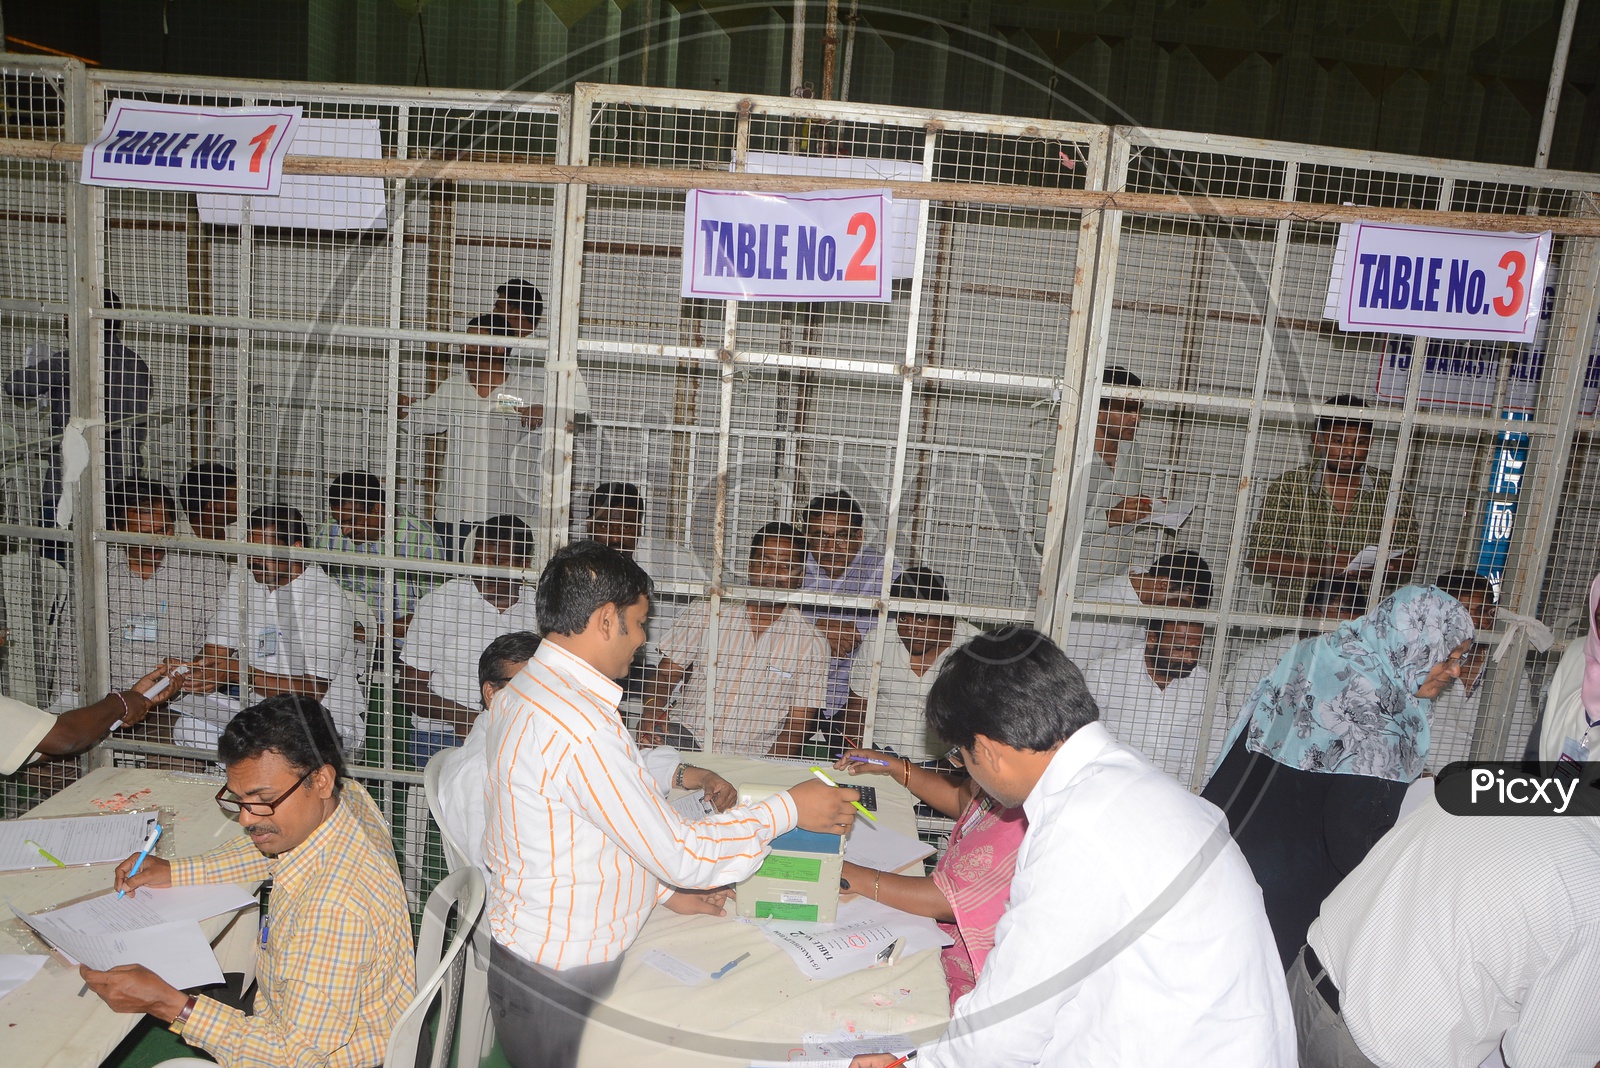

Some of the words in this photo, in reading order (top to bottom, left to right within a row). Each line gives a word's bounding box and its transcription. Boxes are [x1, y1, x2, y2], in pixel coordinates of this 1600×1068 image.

[103, 129, 199, 168] TABLE
[248, 124, 278, 173] 1
[700, 219, 789, 281] TABLE
[1358, 253, 1443, 312] TABLE
